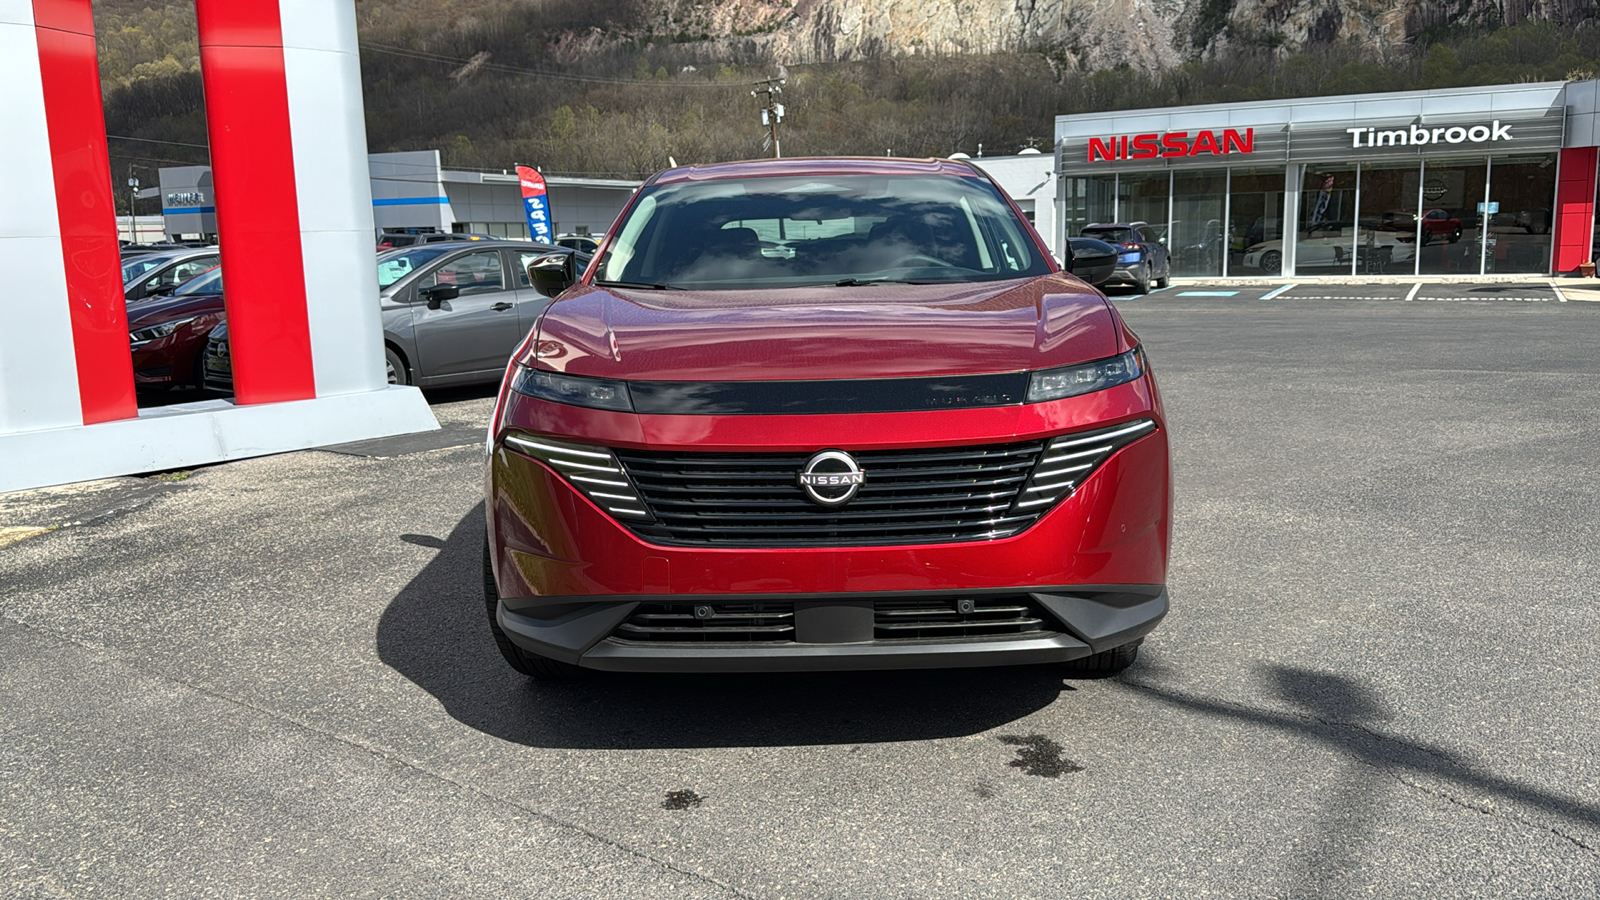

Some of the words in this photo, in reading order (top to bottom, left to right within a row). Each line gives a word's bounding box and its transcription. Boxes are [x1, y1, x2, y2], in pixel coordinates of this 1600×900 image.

[1087, 127, 1254, 163] NISSAN
[1346, 119, 1513, 148] Timbrook
[801, 474, 863, 485] NISSAN
